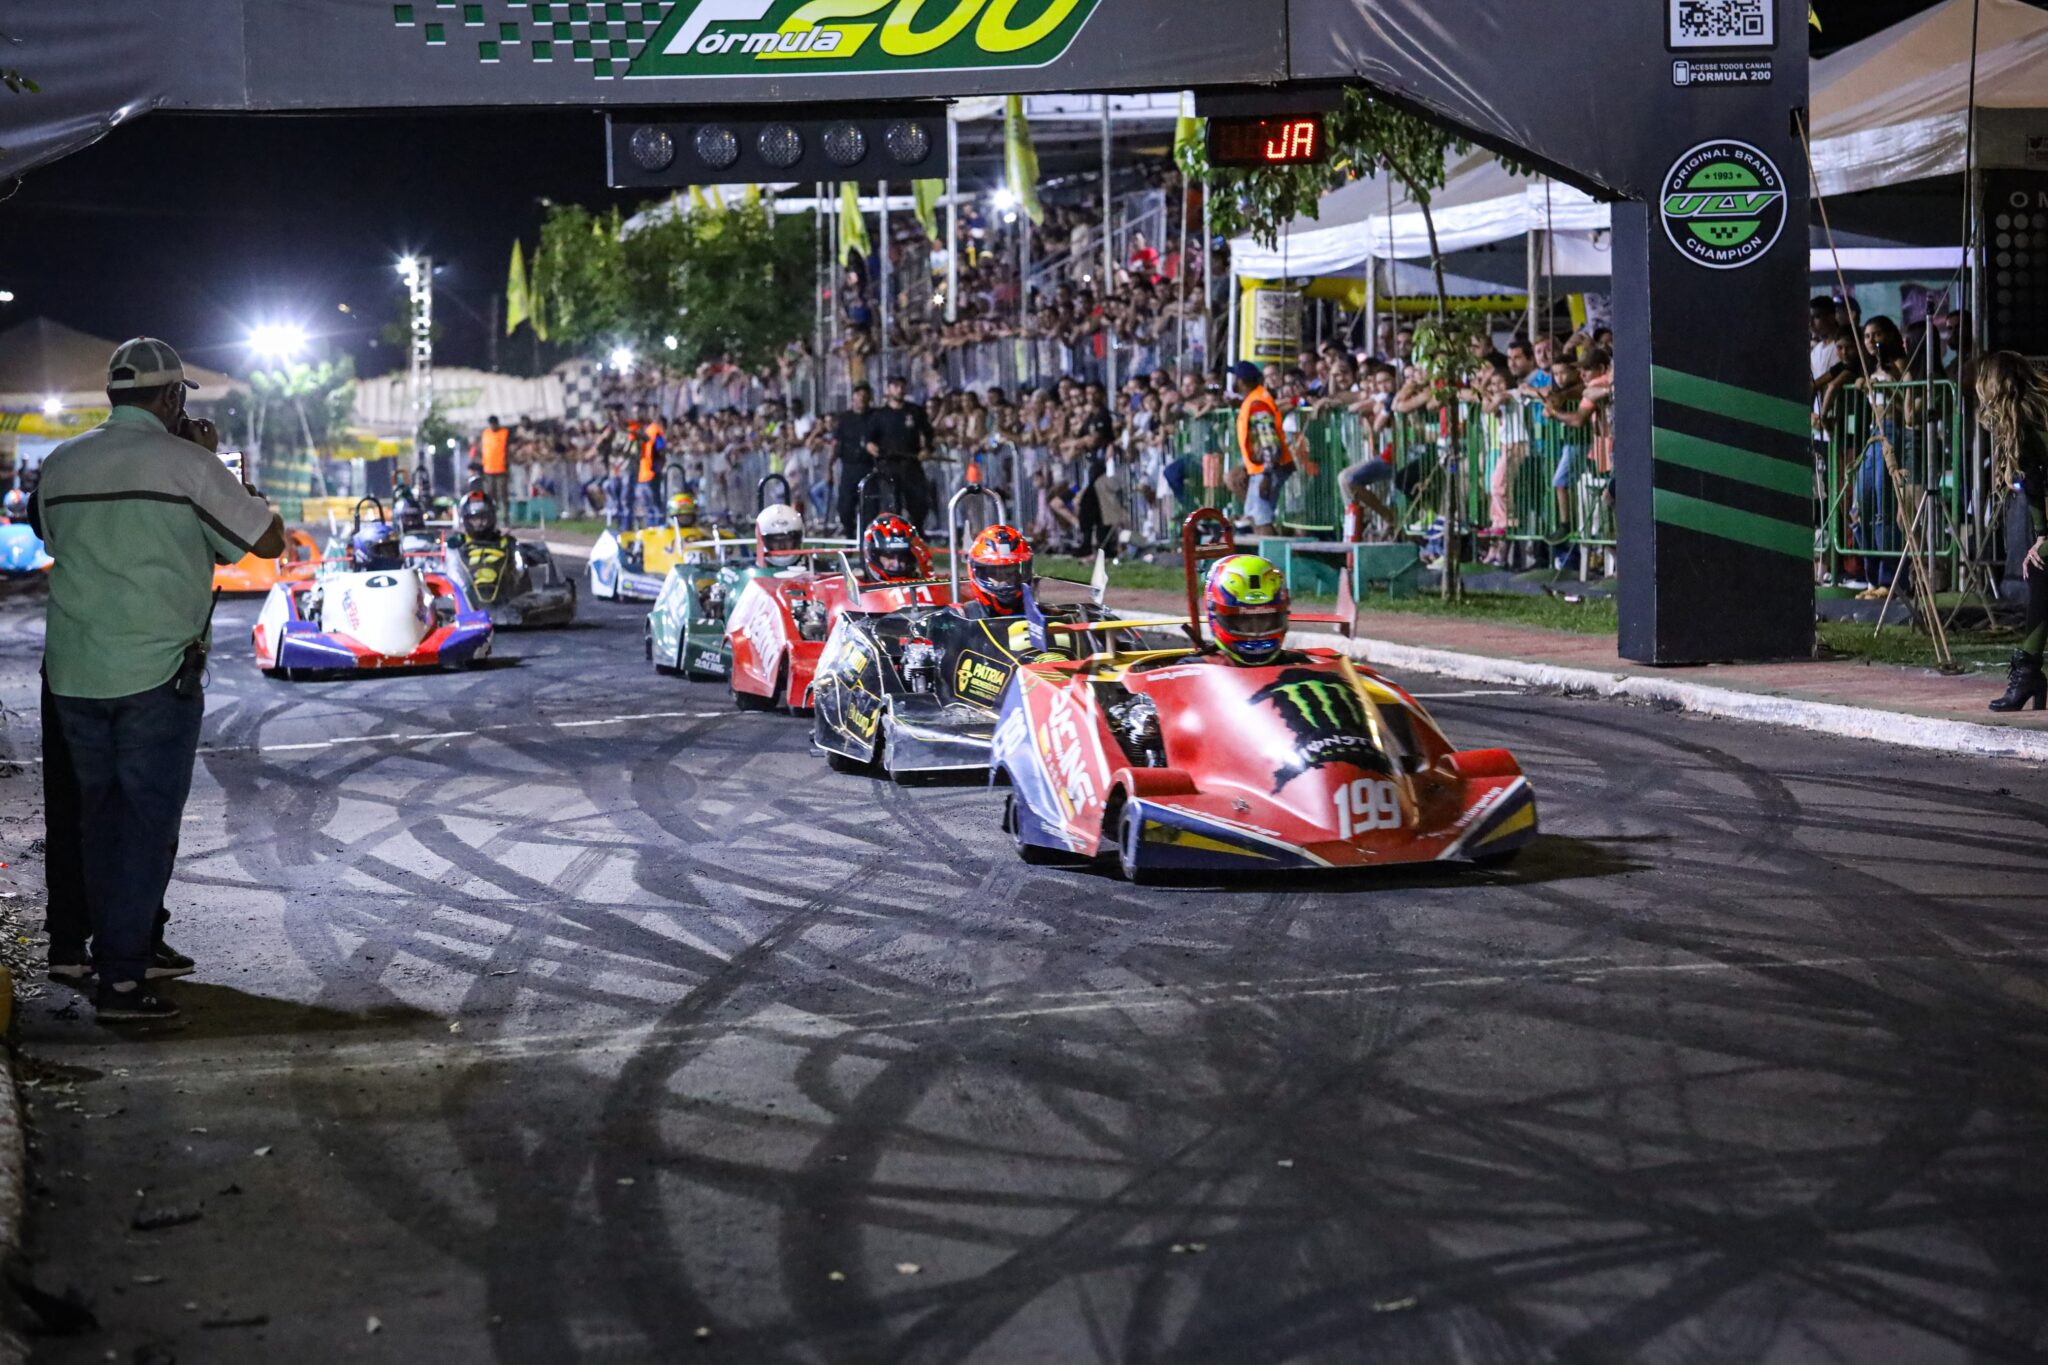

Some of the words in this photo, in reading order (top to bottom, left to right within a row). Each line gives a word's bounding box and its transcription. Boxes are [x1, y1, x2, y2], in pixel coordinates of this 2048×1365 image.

[1690, 63, 1718, 71] ACESSE
[1745, 62, 1772, 70] CANAIS
[1750, 71, 1771, 80] 200
[1673, 148, 1730, 190] ORIGINAL
[1734, 150, 1774, 186] BRAND
[1713, 171, 1734, 180] 1993
[1686, 236, 1762, 260] CHAMPION
[1333, 778, 1401, 840] 199
